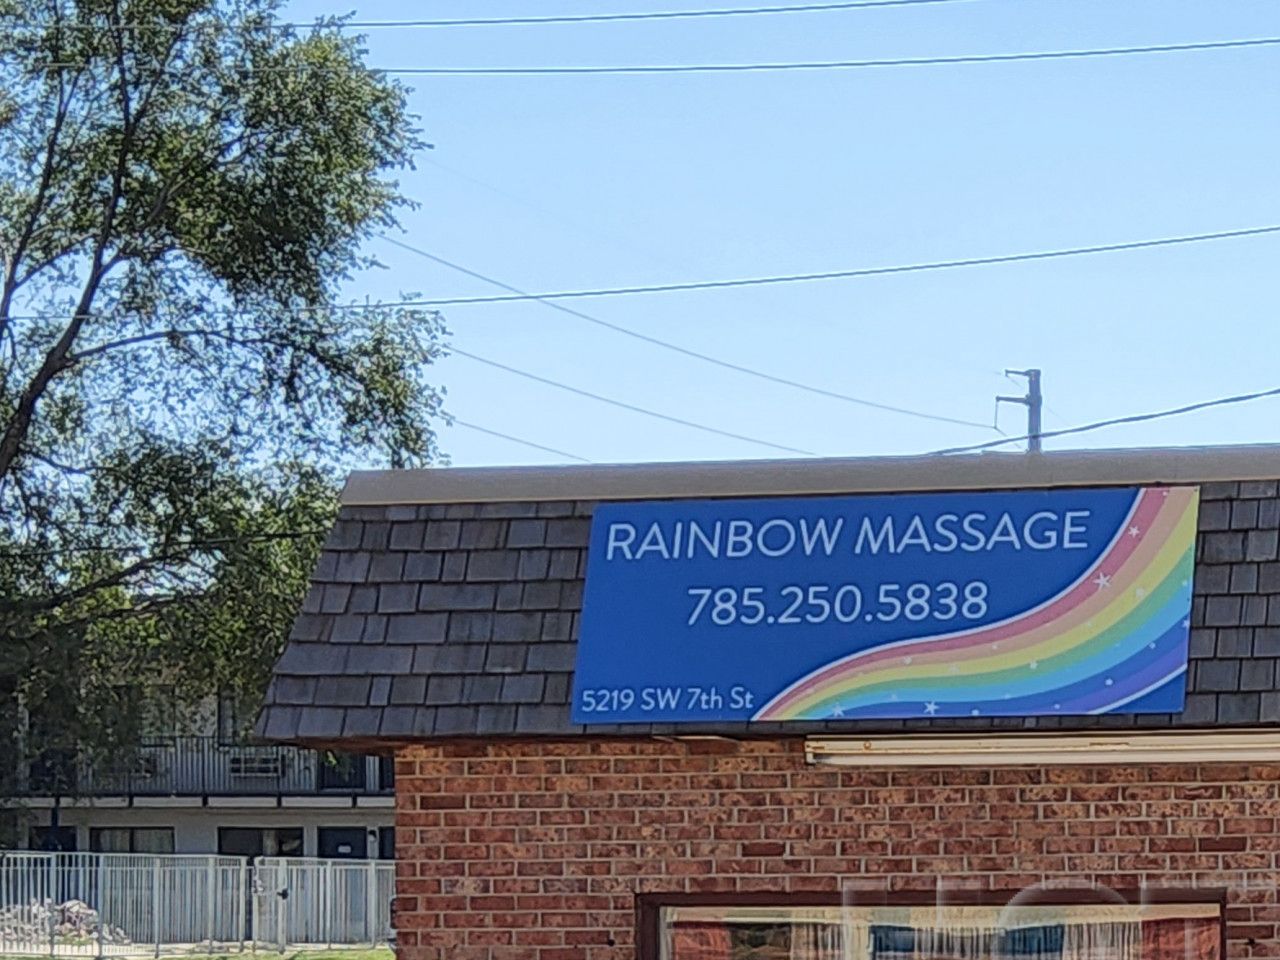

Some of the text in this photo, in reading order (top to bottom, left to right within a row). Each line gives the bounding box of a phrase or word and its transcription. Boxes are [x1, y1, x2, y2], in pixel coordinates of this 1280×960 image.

[606, 510, 1090, 560] RAINBOW MASSAGE
[688, 582, 988, 625] 785.250.5838
[581, 686, 754, 712] 5219 SW 7th St
